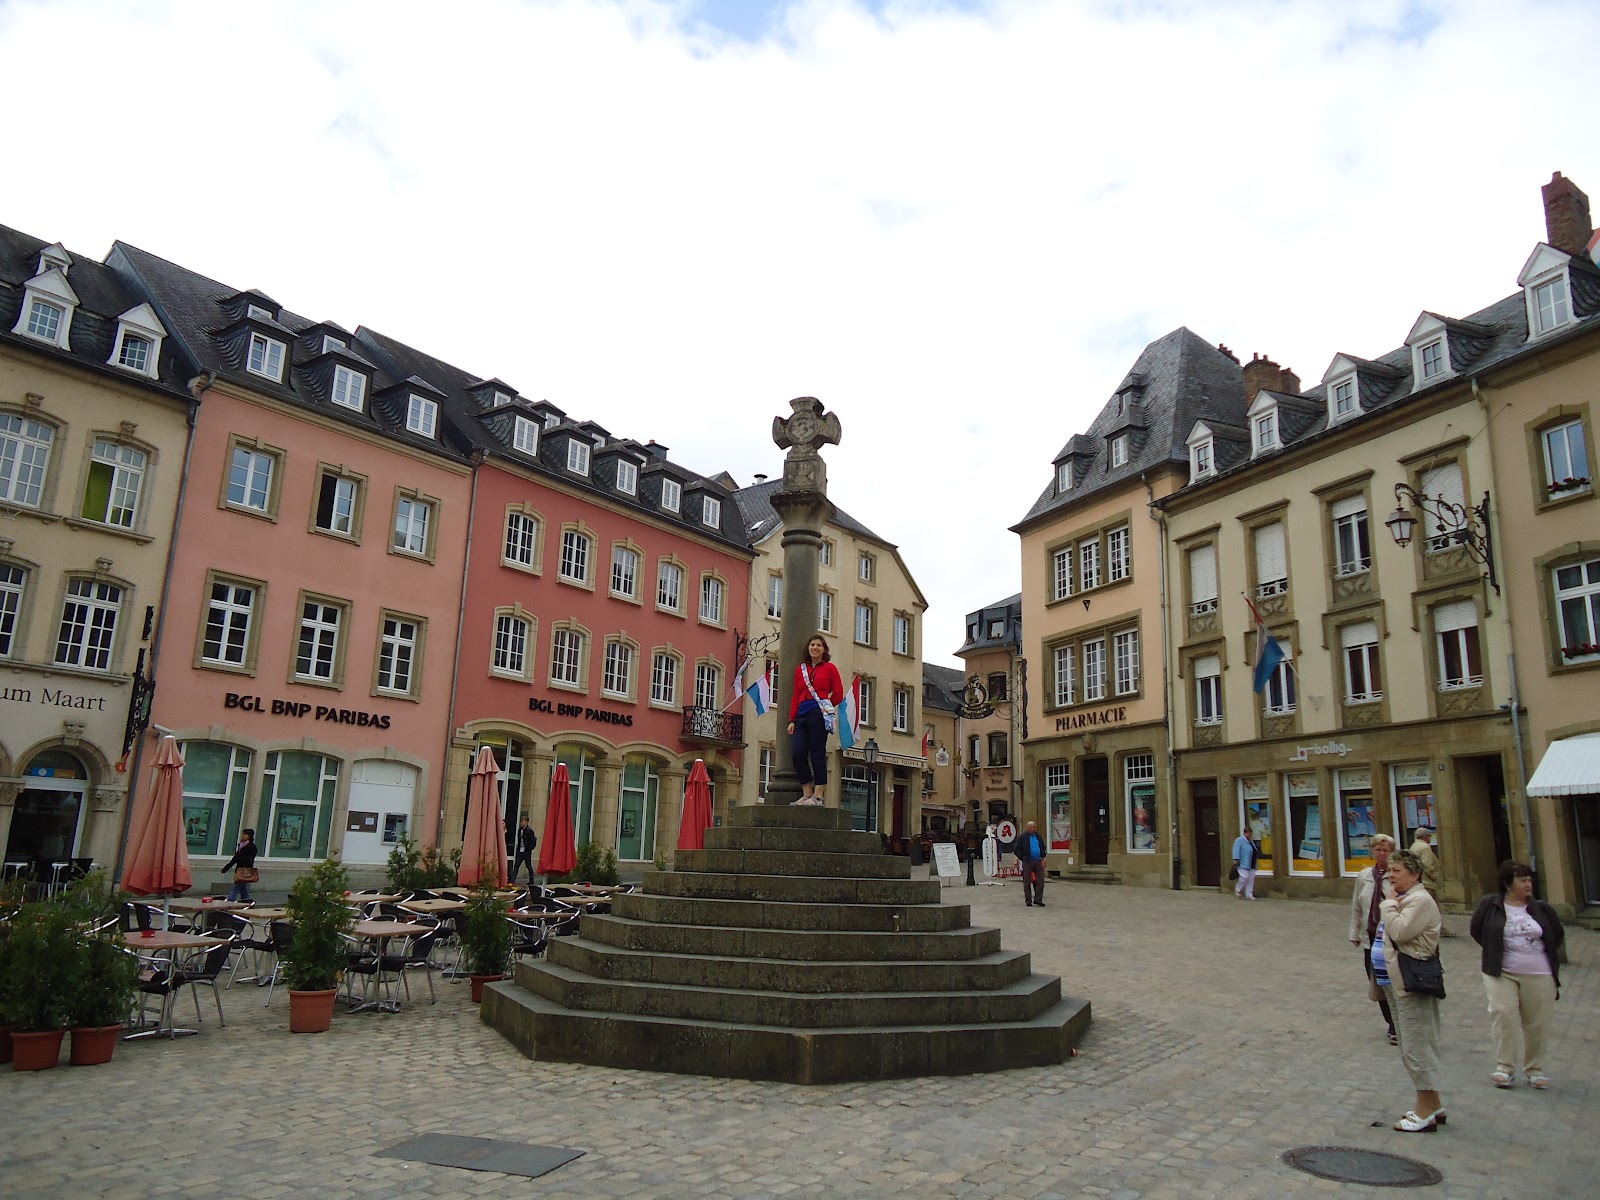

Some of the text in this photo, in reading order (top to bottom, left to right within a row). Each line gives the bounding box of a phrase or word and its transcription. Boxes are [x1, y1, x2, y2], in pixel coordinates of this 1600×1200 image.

[40, 687, 106, 712] Maart
[224, 692, 391, 729] BGL BNP PARIBAS
[529, 697, 633, 727] BGL BNP PARIBAS
[1055, 706, 1127, 732] PHARMACIE
[1314, 740, 1347, 757] bollig
[847, 781, 868, 793] Benelu
